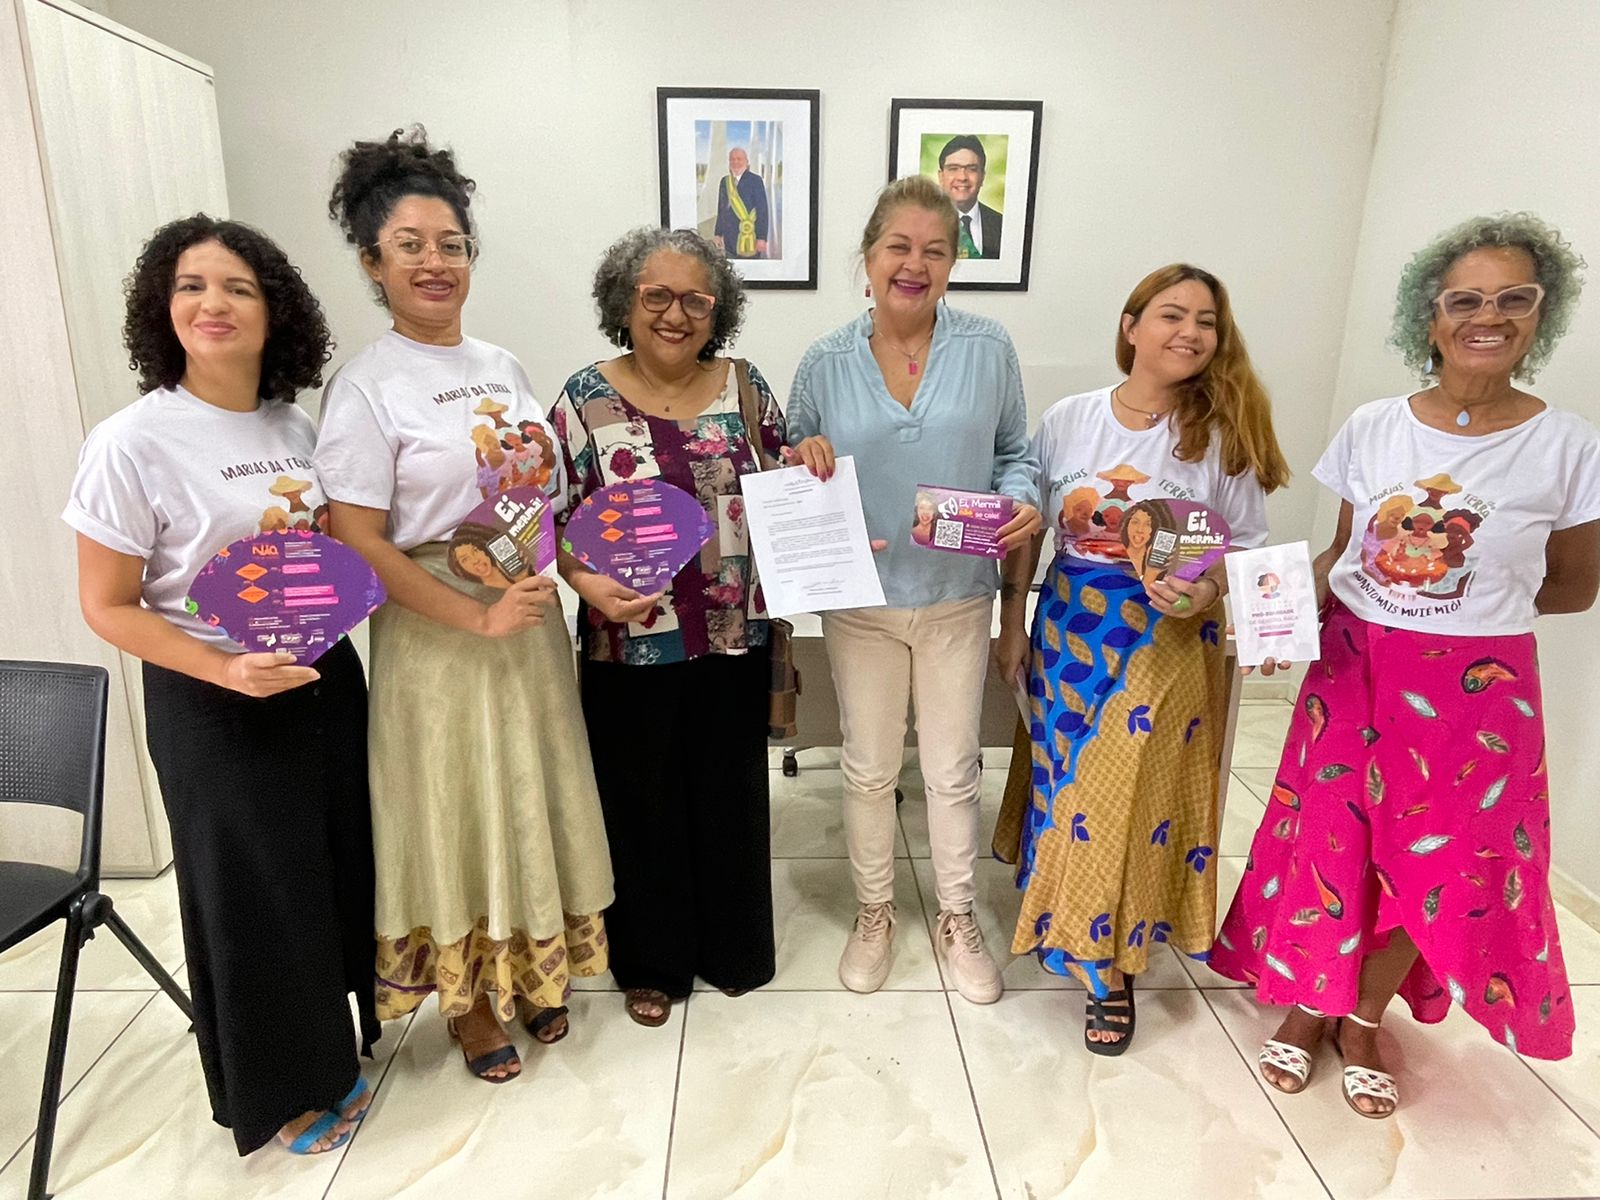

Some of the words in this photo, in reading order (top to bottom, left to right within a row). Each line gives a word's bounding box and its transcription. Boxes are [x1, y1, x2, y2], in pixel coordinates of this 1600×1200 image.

[433, 386, 471, 406] MARIAS
[470, 384, 487, 397] DA
[220, 461, 269, 481] MARIAS
[268, 460, 286, 474] DA
[1187, 510, 1211, 535] Ei,
[1375, 596, 1400, 614] MAIS
